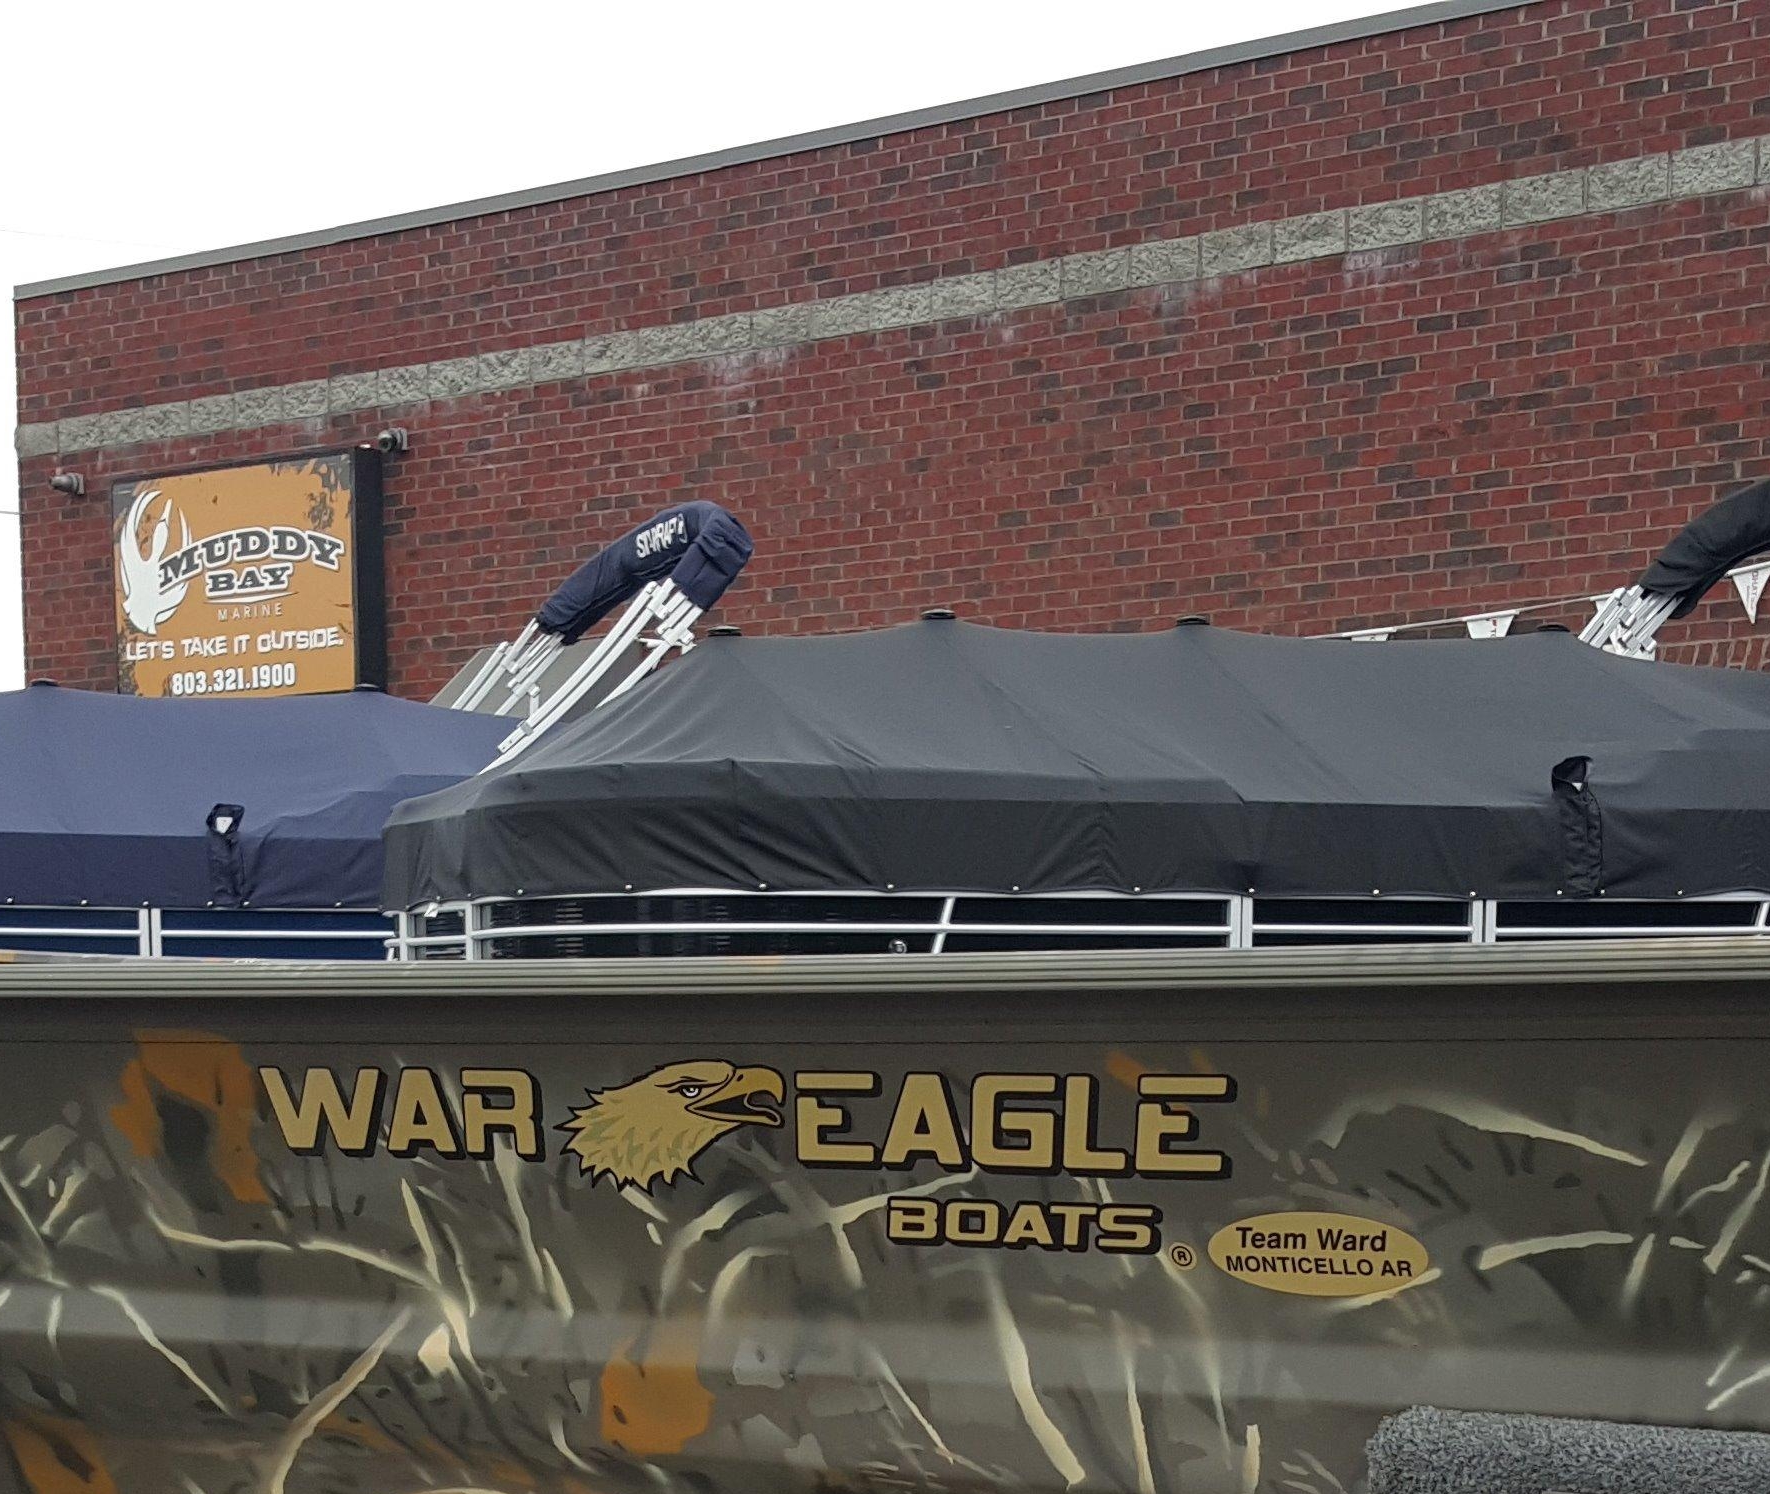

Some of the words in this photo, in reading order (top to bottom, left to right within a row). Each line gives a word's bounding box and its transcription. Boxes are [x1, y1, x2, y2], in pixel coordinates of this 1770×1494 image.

[158, 528, 343, 591] MUDDY
[207, 564, 292, 594] BAY
[217, 603, 284, 622] MARINE
[126, 640, 175, 661] LET'S
[181, 636, 228, 657] TAKE
[233, 634, 251, 655] IT
[257, 627, 344, 653] OUTSIDE.
[171, 662, 296, 696] 803.321.1900
[257, 1066, 545, 1163] WAR
[792, 1070, 1233, 1178] EAGLE
[886, 1198, 1162, 1255] BOATS
[1236, 1227, 1307, 1250] Team
[1317, 1229, 1387, 1252] Ward
[1226, 1256, 1373, 1275] MONTICELLO
[1381, 1260, 1412, 1277] AR
